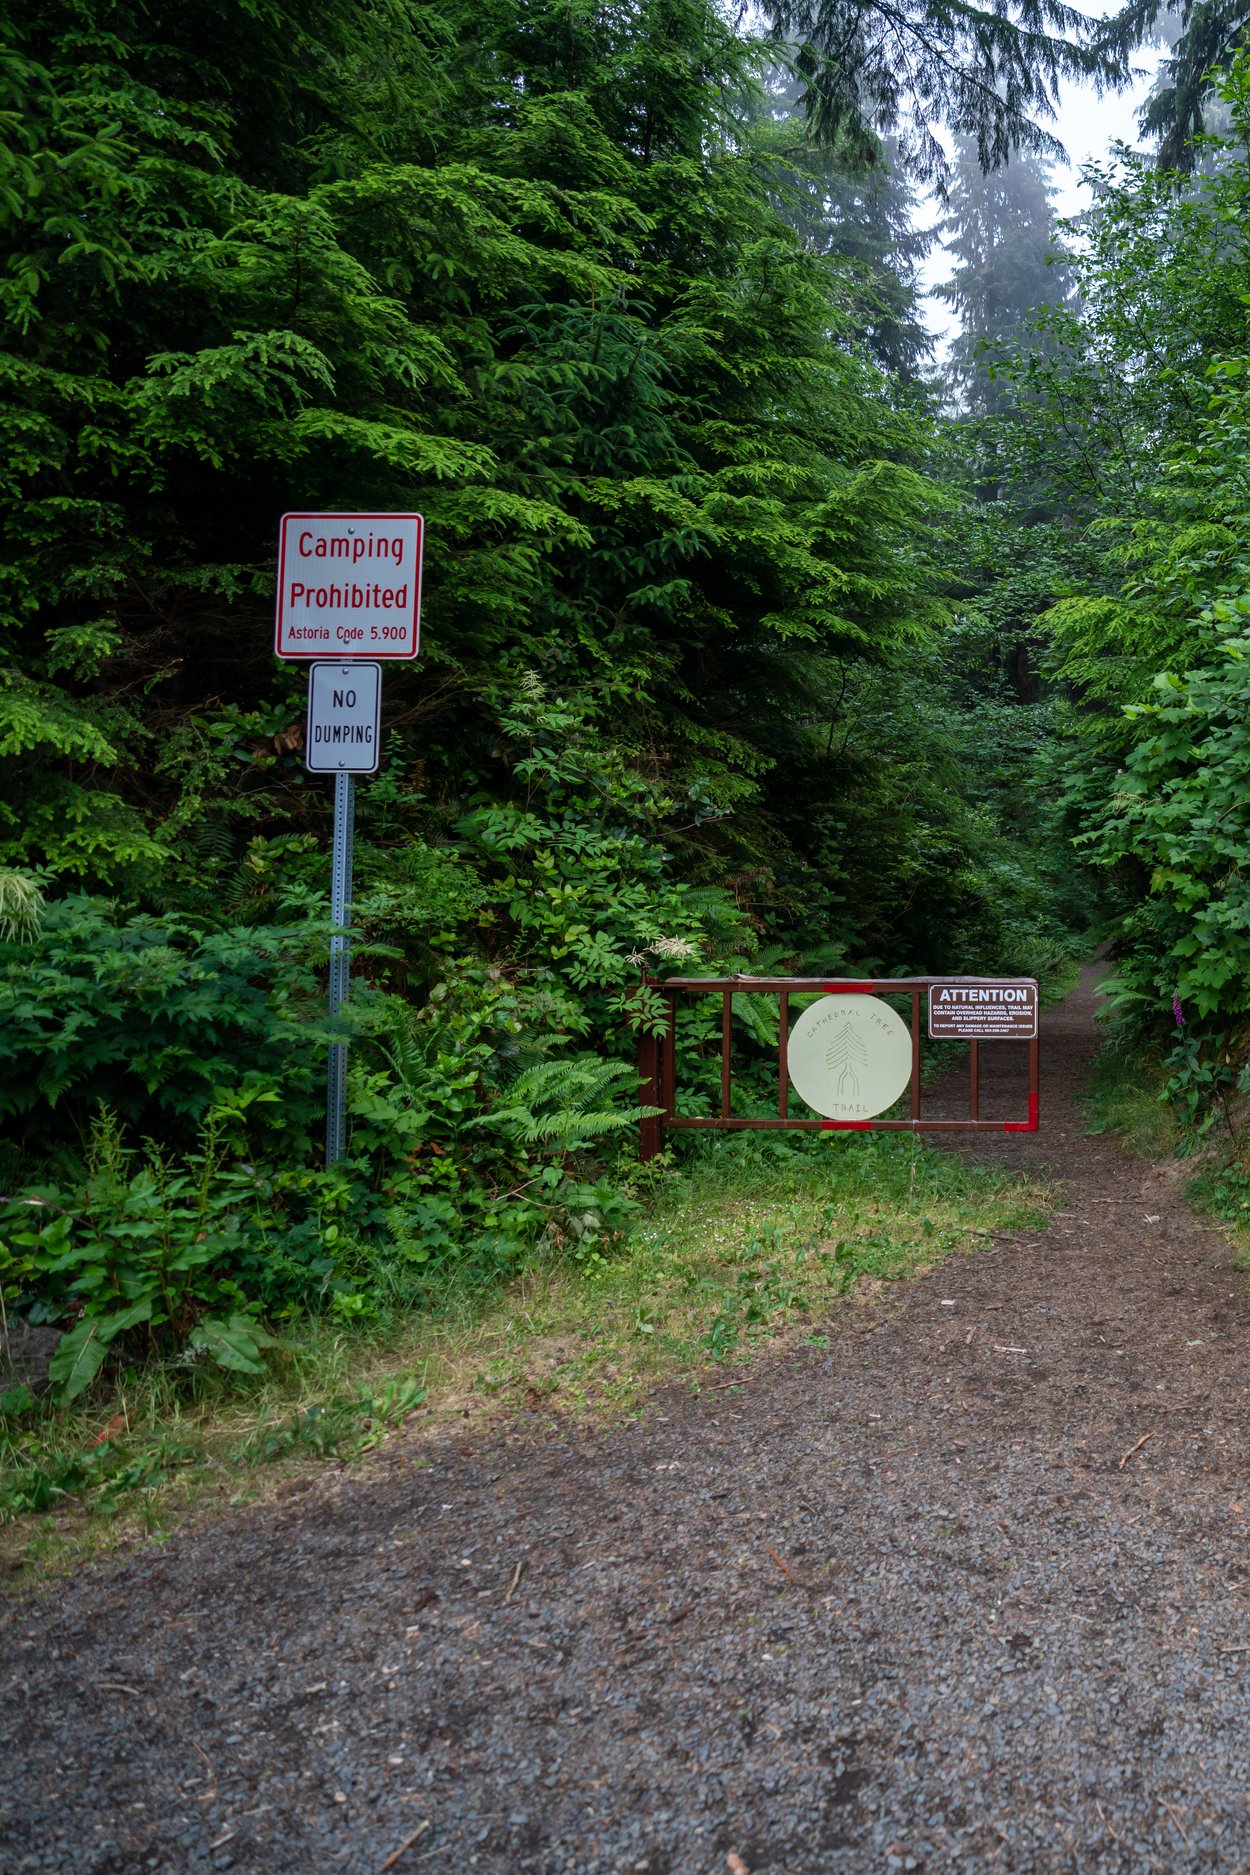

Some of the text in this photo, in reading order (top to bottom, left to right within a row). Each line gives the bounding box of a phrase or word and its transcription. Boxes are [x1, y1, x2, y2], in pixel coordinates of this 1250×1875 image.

[298, 531, 404, 566] Camping
[290, 582, 408, 609] Prohibited
[288, 626, 407, 640] Astoria Code 5.900
[332, 690, 356, 708] NO
[315, 725, 372, 744] DUMPING
[940, 989, 1027, 1002] ATTENTION
[807, 1010, 894, 1038] CATHEDRAL TREE
[833, 1103, 868, 1112] TRAIL
